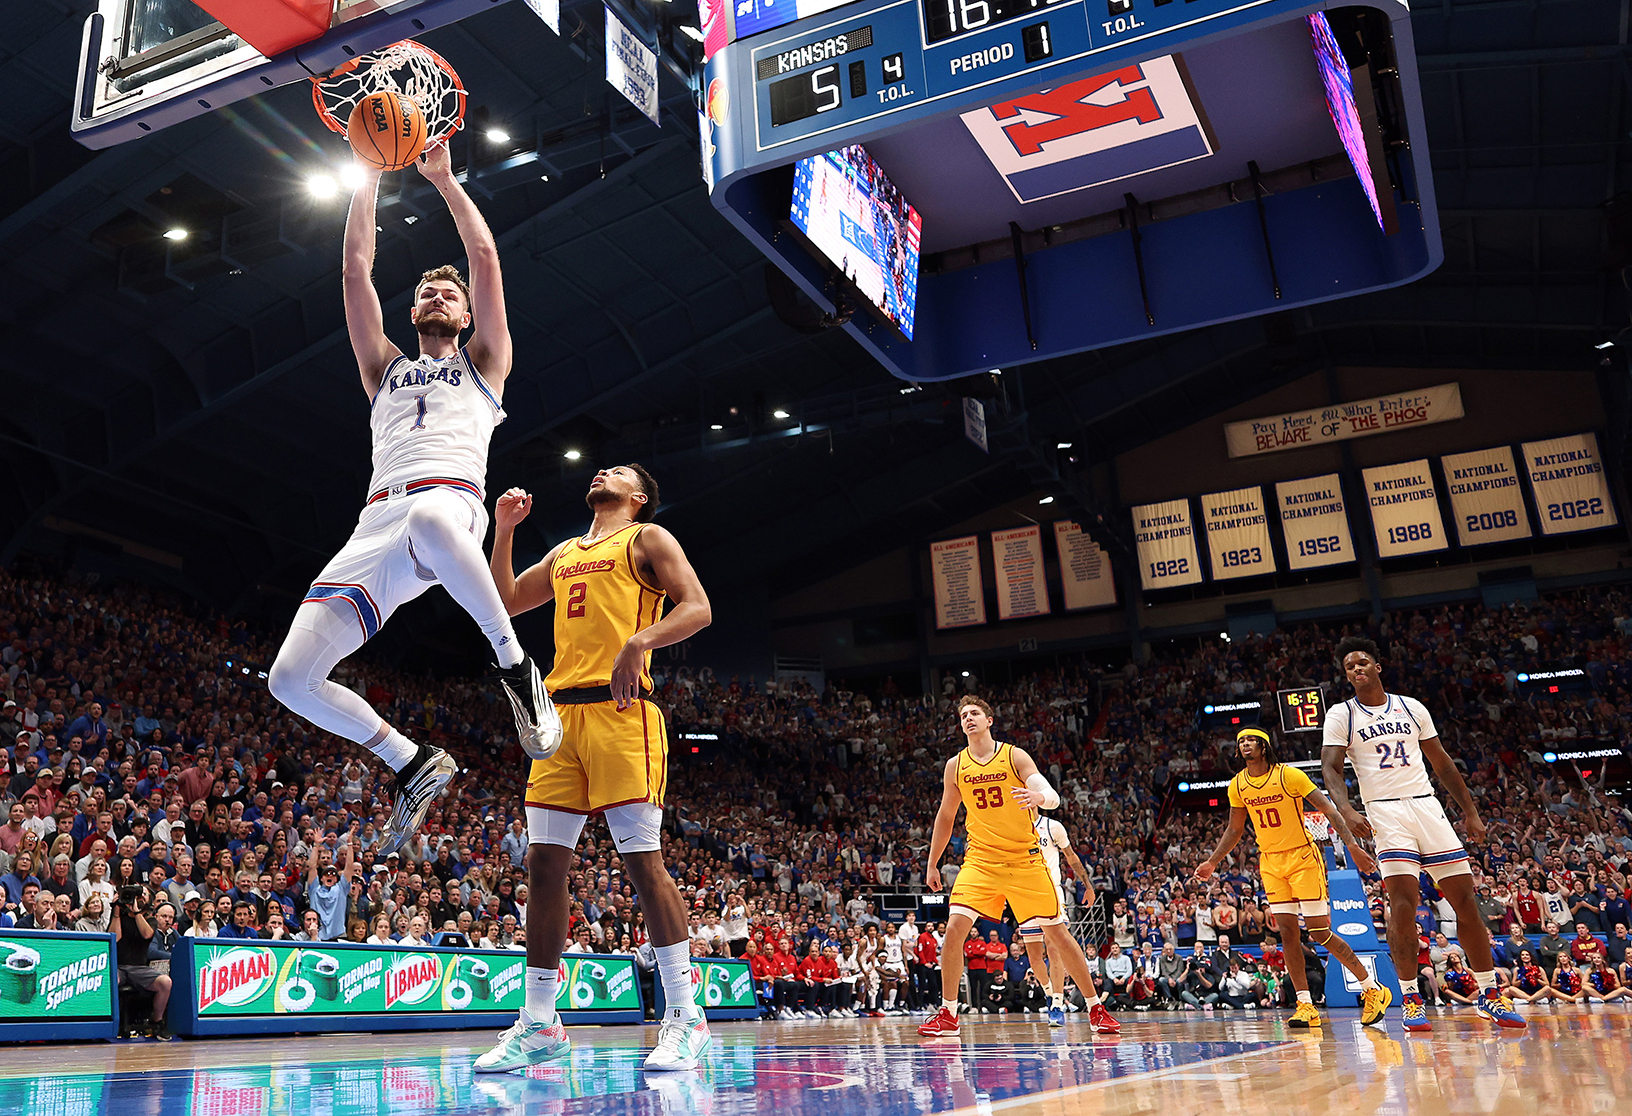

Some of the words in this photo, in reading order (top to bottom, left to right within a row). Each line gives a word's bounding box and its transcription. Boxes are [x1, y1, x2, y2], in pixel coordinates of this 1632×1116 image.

[1102, 14, 1145, 36] T.O.L.
[1040, 25, 1050, 54] 1
[778, 35, 848, 74] KANSAS
[950, 42, 1014, 75] PERIOD
[884, 56, 902, 78] 4
[811, 66, 840, 112] 5
[876, 84, 915, 103] T.O.L.
[371, 98, 389, 132] NCAA
[394, 93, 414, 137] Wilson
[389, 367, 462, 395] KANSAS
[410, 394, 428, 431] 1
[1252, 421, 1277, 435] Pay
[1282, 414, 1317, 428] Heed,
[1321, 408, 1340, 421] All
[1379, 396, 1429, 413] Enter:
[1256, 427, 1312, 451] BEWARE
[1321, 422, 1340, 437] OF
[1534, 448, 1592, 467] NATIONAL
[1453, 462, 1508, 480] NATIONAL
[1531, 462, 1602, 483] CHAMPIONS
[1373, 475, 1426, 492] NATIONAL
[1450, 475, 1517, 495] CHAMPIONS
[1285, 489, 1336, 506] NATIONAL
[1370, 488, 1435, 507] CHAMPIONS
[1210, 501, 1258, 517] NATIONAL
[1282, 502, 1343, 520] CHAMPIONS
[1547, 497, 1604, 521] 2022
[1140, 513, 1185, 529] NATIONAL
[1207, 514, 1266, 532] CHAMPIONS
[1466, 510, 1518, 532] 2008
[1136, 526, 1192, 543] CHAMPIONS
[1387, 522, 1433, 544] 1988
[1298, 535, 1341, 557] 1952
[1221, 547, 1262, 568] 1923
[555, 558, 616, 580] Cyclones
[1150, 558, 1189, 579] 1922
[567, 581, 588, 619] 2
[1021, 638, 1036, 650] 21
[1529, 672, 1555, 681] KONICA
[1555, 669, 1585, 678] MINOLTA
[1214, 704, 1236, 712] KONICA
[1287, 691, 1319, 706] 16:15
[1297, 704, 1319, 727] 12
[1357, 722, 1412, 742] KANSAS
[1375, 740, 1411, 769] 24
[1557, 751, 1588, 761] KONICA
[1588, 748, 1622, 758] MINOLTA
[963, 772, 1007, 785] Cyclones
[1190, 782, 1214, 790] KONICA
[973, 786, 1004, 810] 33
[1244, 793, 1284, 807] Cyclones
[1256, 808, 1282, 828] 10
[1332, 900, 1365, 912] HyVee
[1548, 899, 1564, 913] 21
[39, 953, 108, 996] TORNADO
[199, 953, 272, 1012] LIBMAN
[339, 957, 382, 993] TORNADO
[385, 958, 440, 1010] LIBMAN
[45, 985, 74, 1011] Spin
[76, 974, 103, 996] Mop
[344, 984, 362, 1004] Spin
[363, 975, 381, 992] Mop
